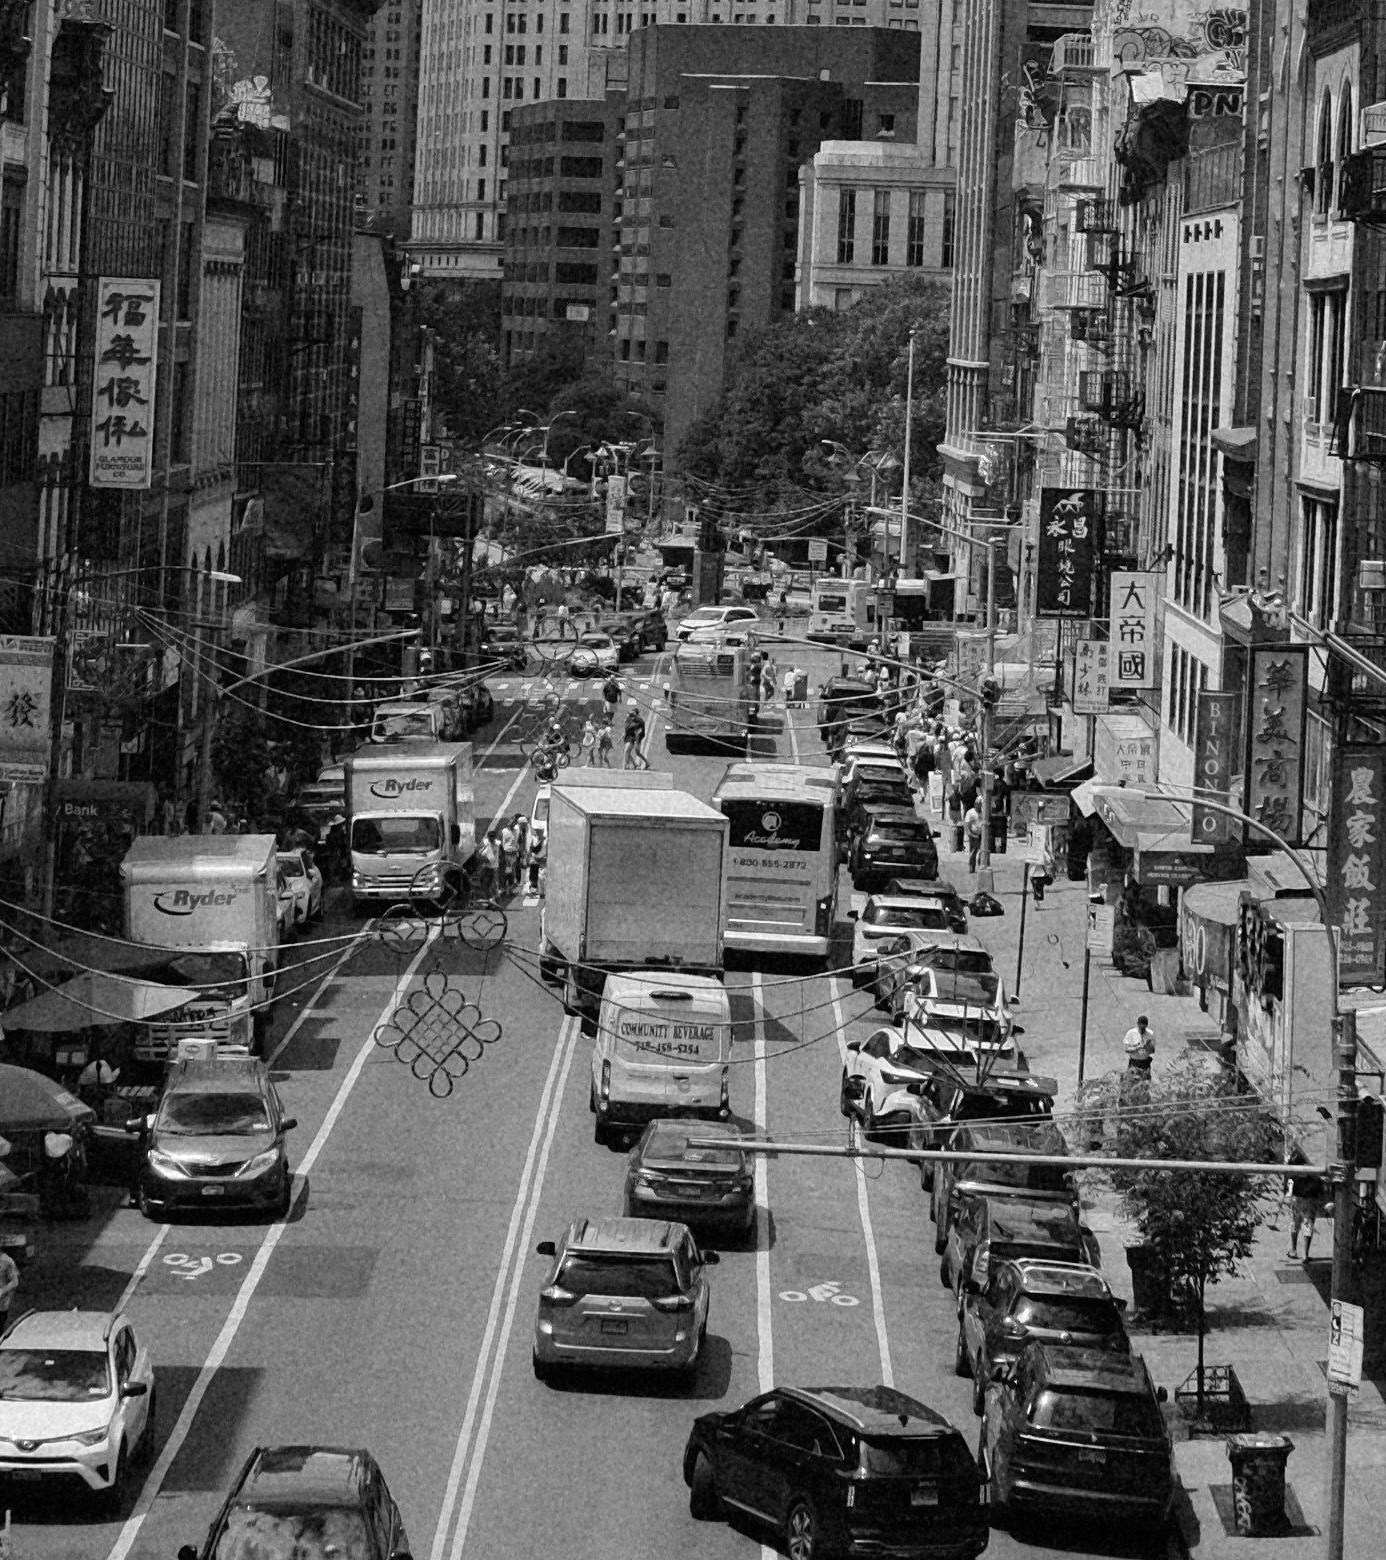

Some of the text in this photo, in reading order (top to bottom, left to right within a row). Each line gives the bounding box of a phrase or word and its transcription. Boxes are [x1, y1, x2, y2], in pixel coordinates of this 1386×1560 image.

[1119, 581, 1147, 680] 大帝國
[7, 693, 38, 728] 發
[385, 778, 433, 794] Ryder
[65, 803, 98, 816] Bank
[744, 830, 801, 848] Academy
[173, 889, 236, 911] Ryder
[621, 1022, 715, 1040] COMMUNITY BEVERAGE
